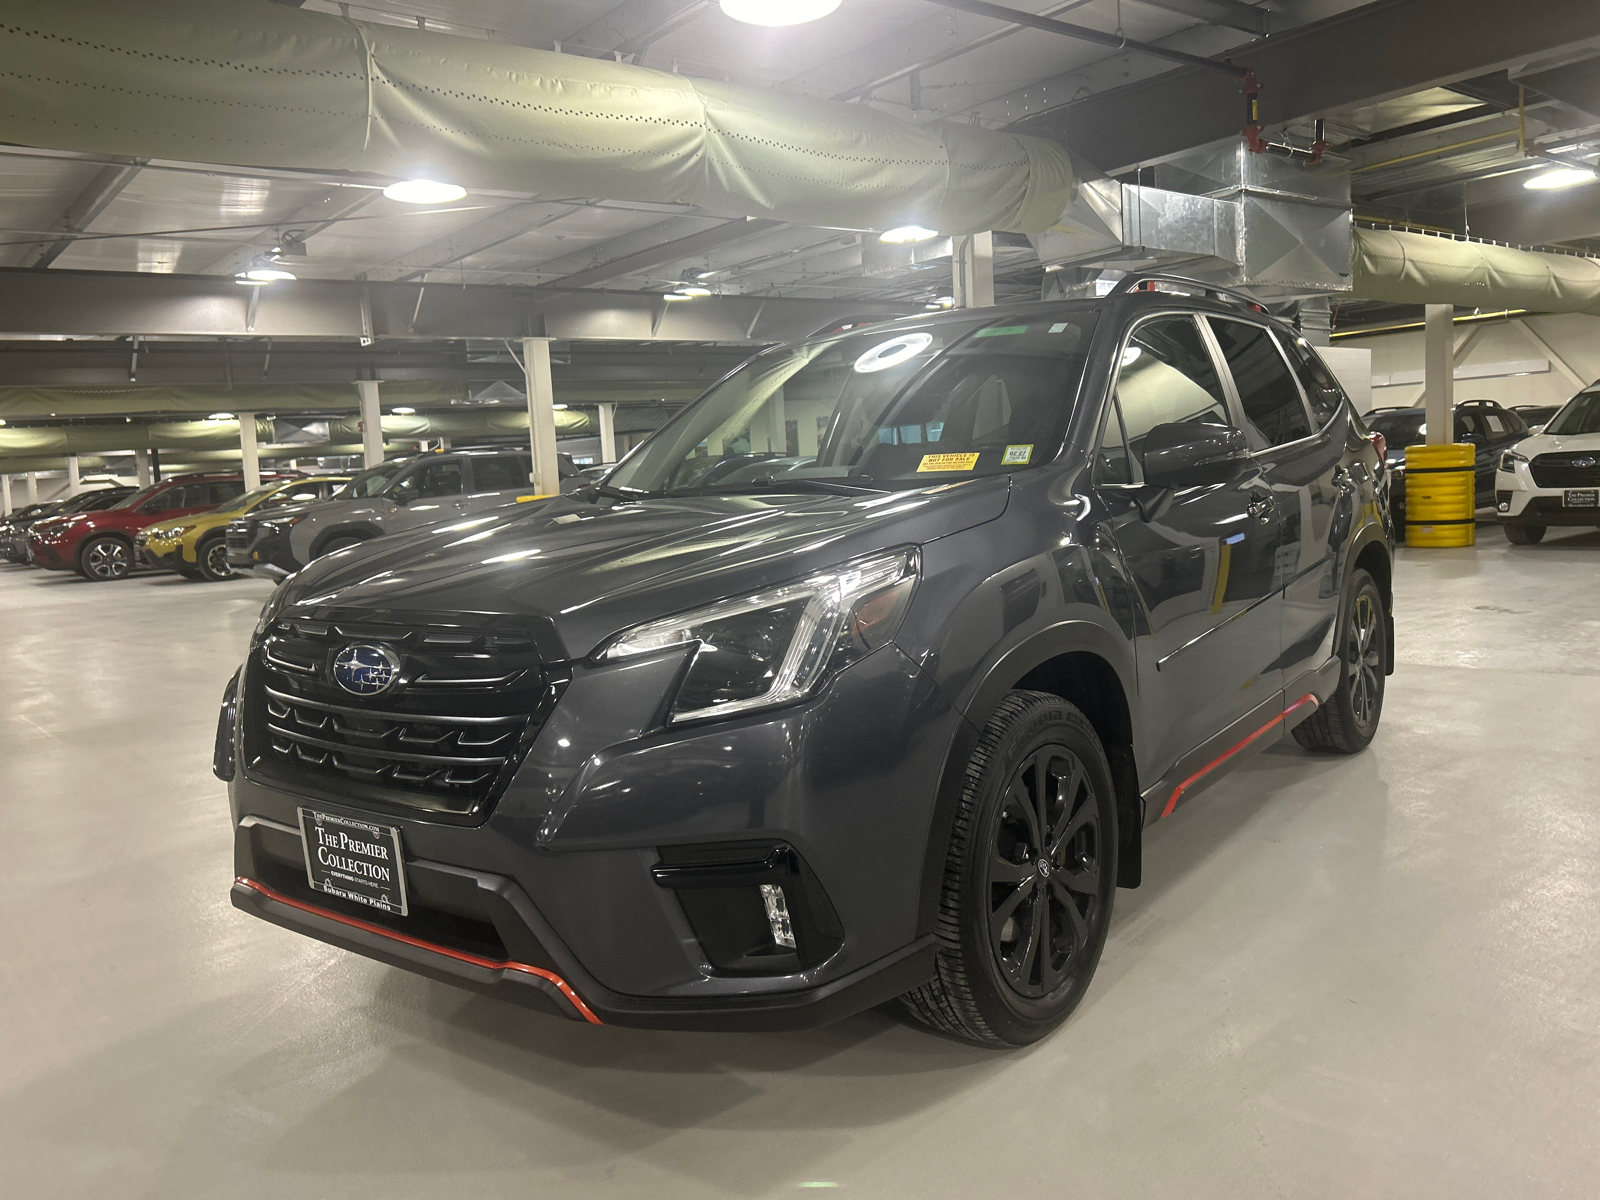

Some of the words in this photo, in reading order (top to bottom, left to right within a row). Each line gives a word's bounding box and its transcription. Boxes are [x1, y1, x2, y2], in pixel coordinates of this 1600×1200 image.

[315, 826, 339, 849] THE
[339, 831, 388, 860] PREMIER
[317, 846, 390, 881] COLLECTION
[323, 885, 347, 898] Subaru
[347, 891, 368, 904] White
[369, 898, 391, 911] Plains
